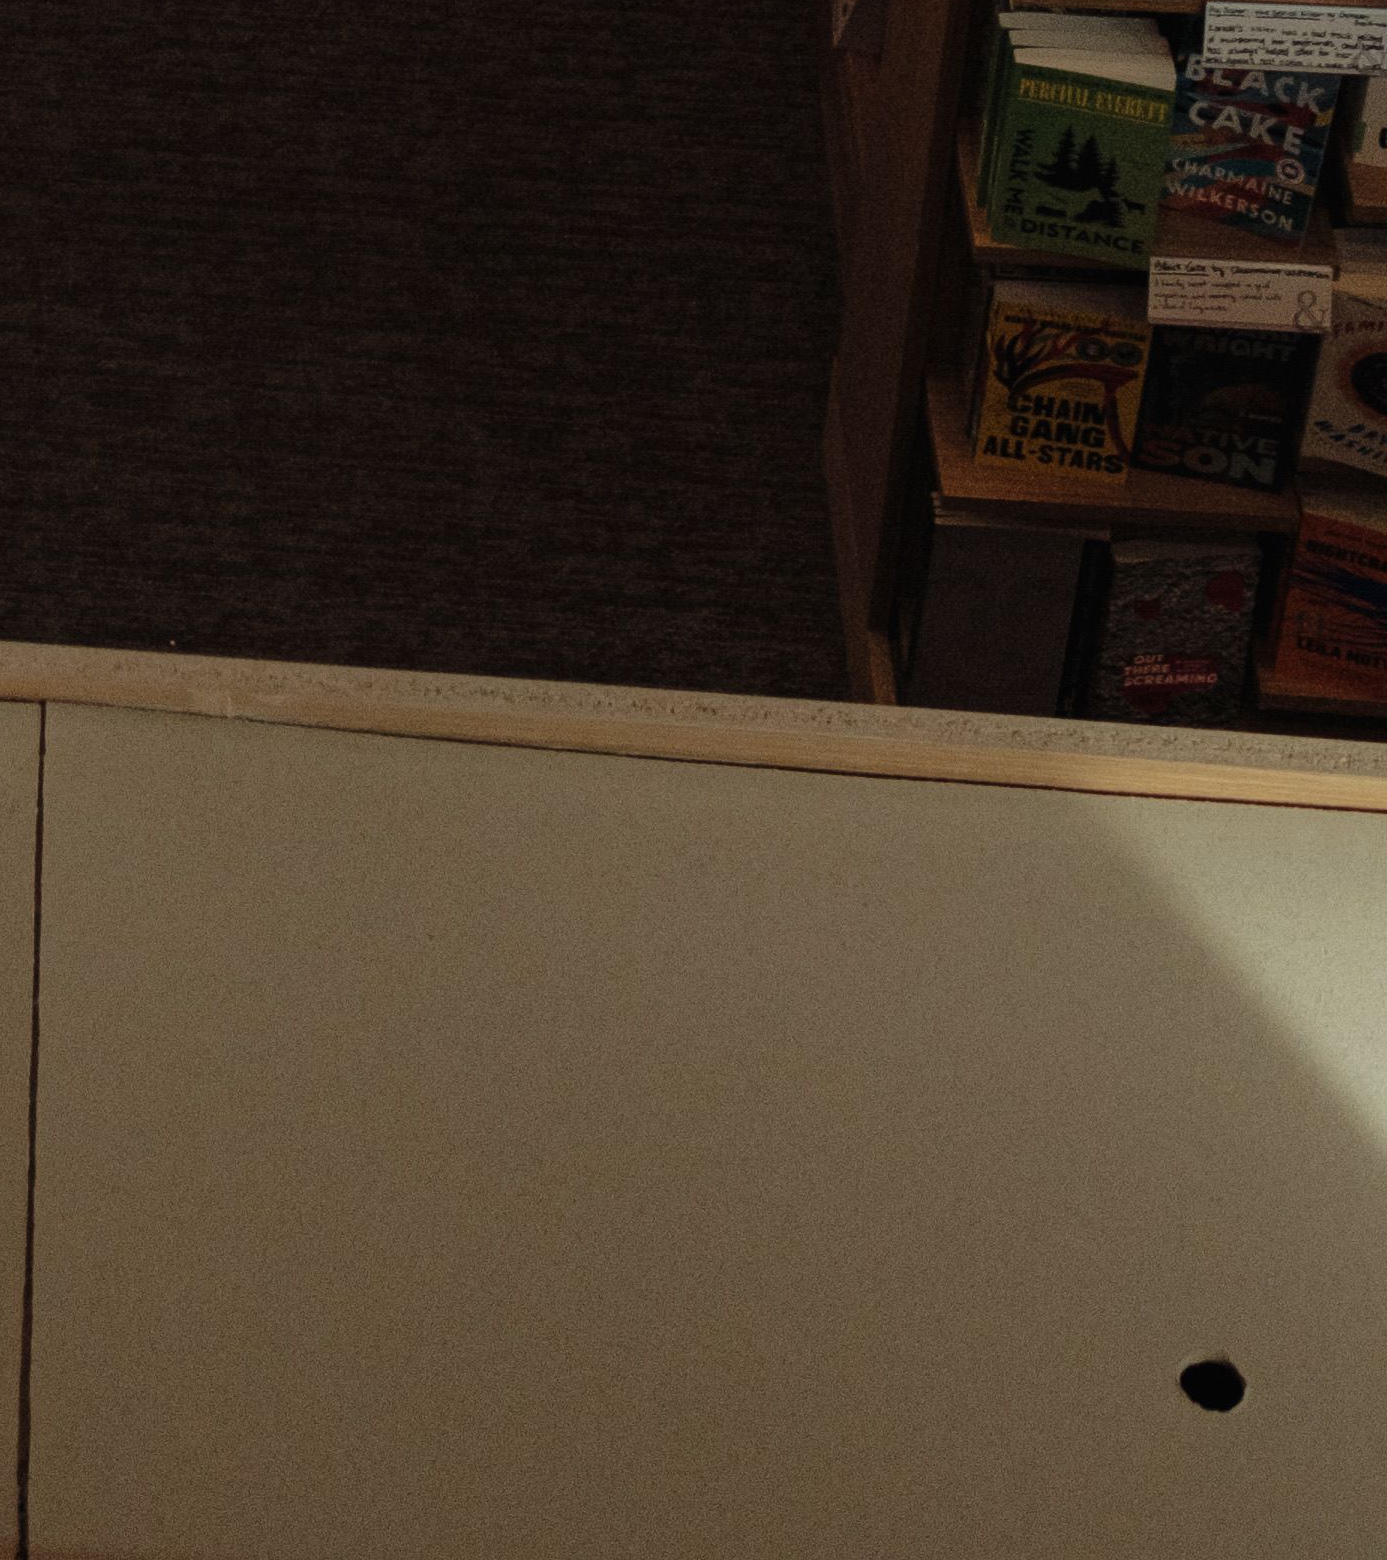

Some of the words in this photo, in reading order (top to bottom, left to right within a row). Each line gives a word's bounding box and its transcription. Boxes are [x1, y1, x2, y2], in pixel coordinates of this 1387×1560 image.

[1187, 98, 1306, 157] CAKE
[1166, 178, 1294, 233] WILKERSON
[1171, 156, 1293, 206] CHARMAINE
